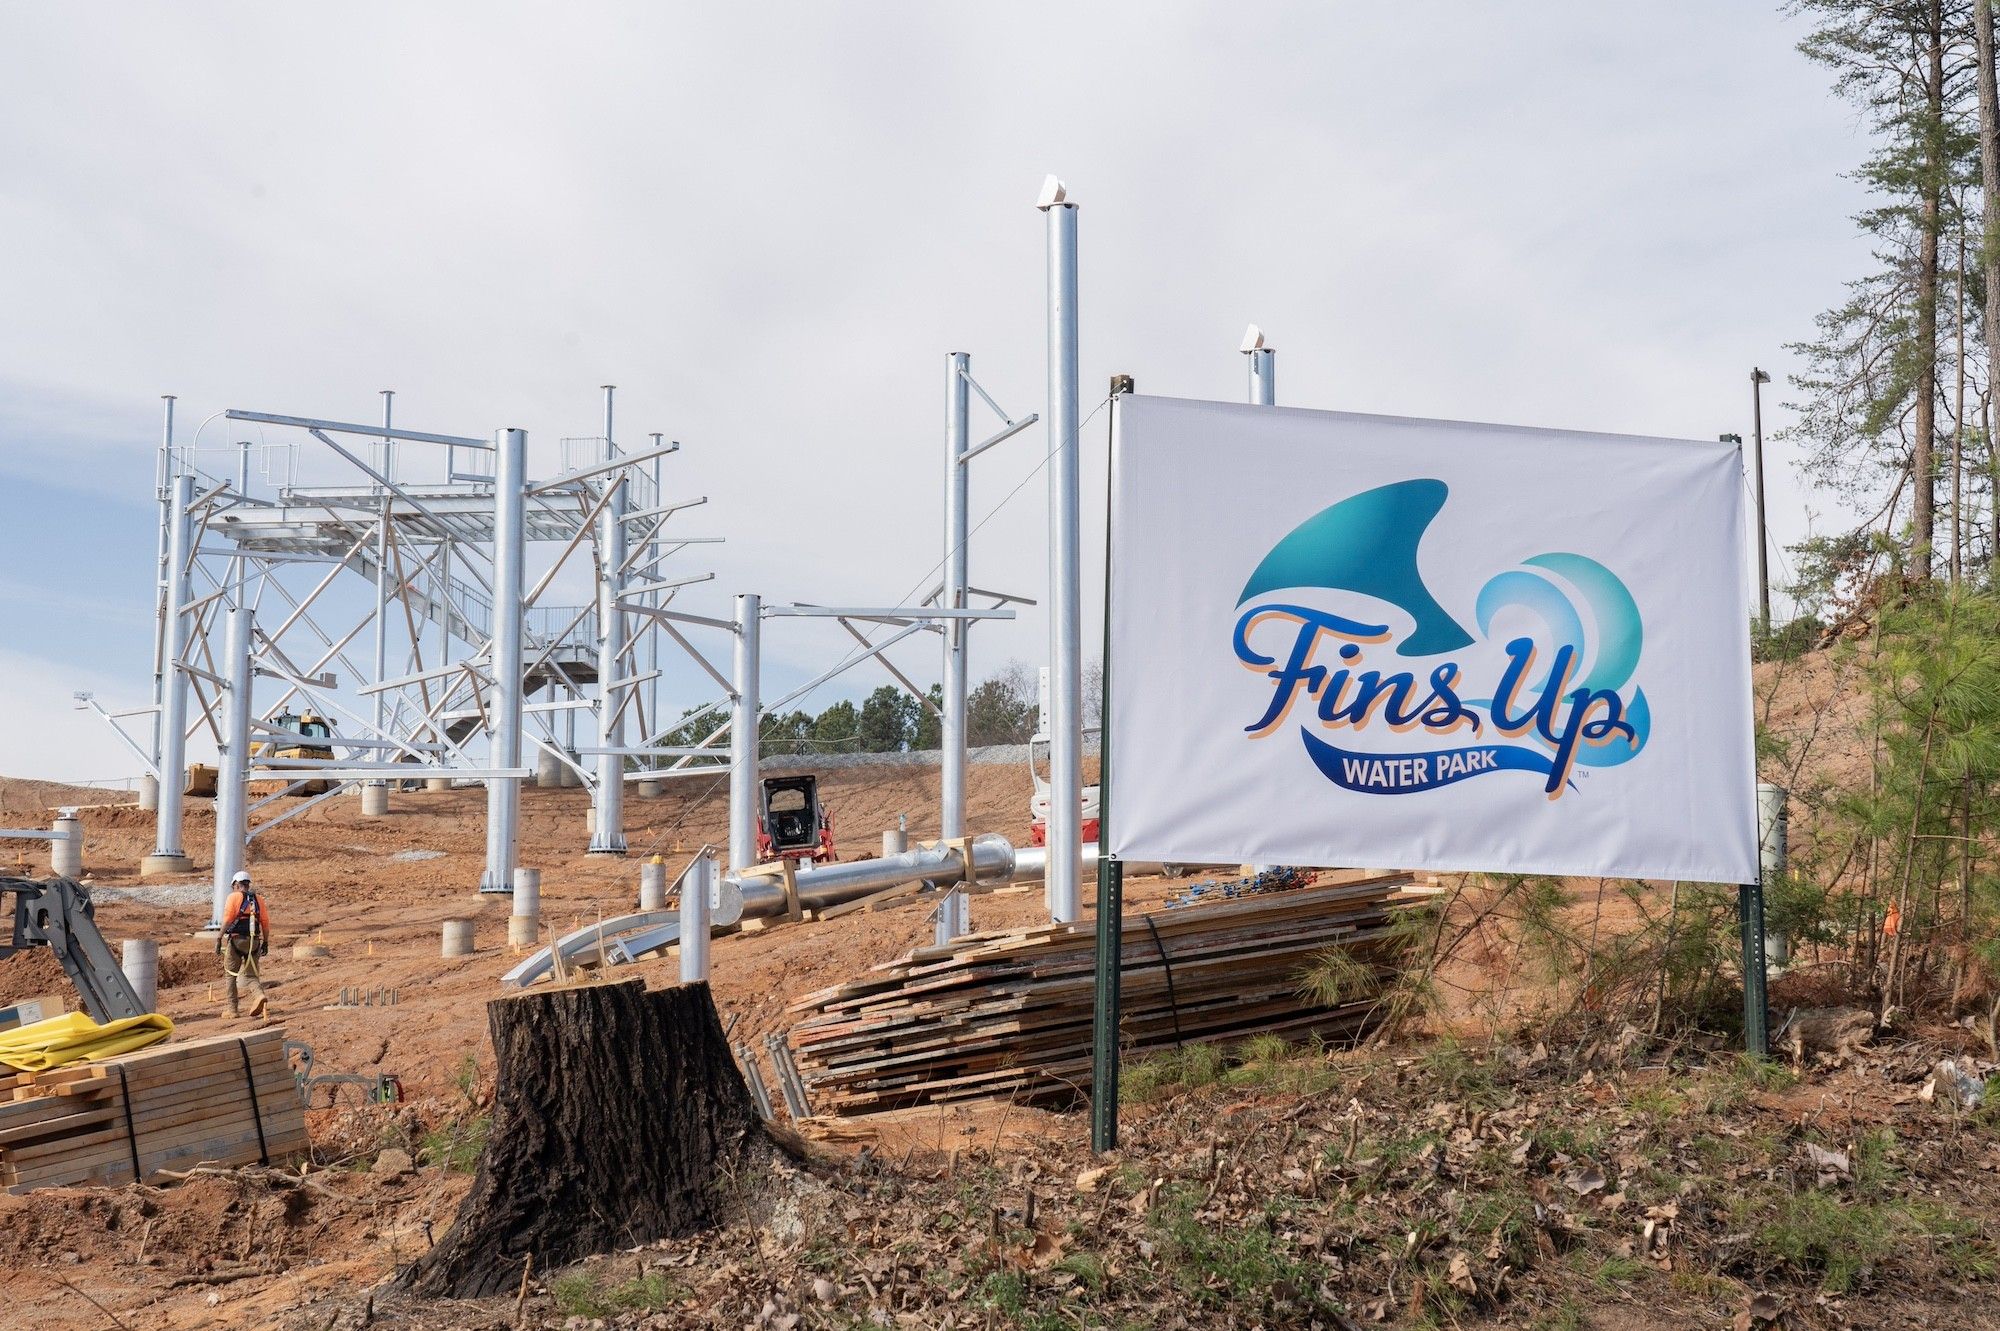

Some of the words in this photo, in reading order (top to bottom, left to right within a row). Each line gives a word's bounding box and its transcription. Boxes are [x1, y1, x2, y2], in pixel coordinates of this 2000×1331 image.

[1232, 603, 1481, 740] Fins
[1490, 636, 1639, 801] Up
[1342, 757, 1429, 788] WATER
[1436, 749, 1498, 781] PARK
